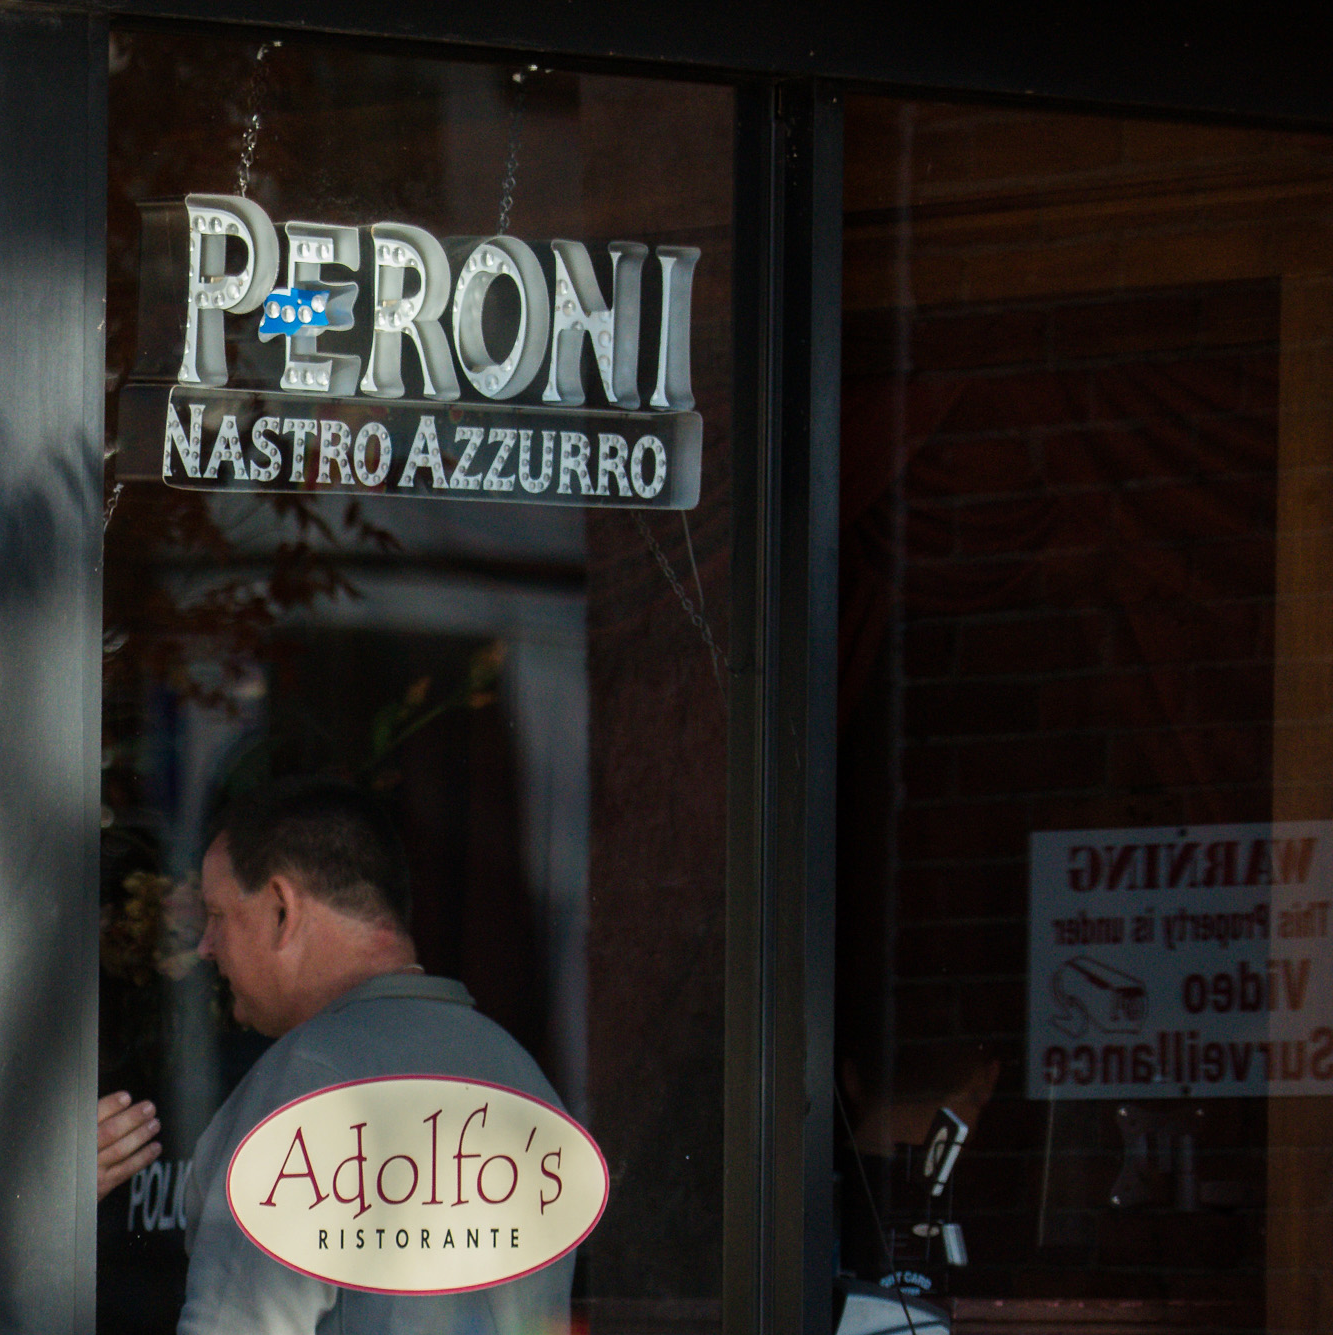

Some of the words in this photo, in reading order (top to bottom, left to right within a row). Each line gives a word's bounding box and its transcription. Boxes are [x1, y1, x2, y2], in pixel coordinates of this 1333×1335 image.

[178, 193, 701, 410] PERONI
[164, 402, 391, 486] NASTRO
[398, 415, 666, 499] AZZURRO
[259, 1102, 563, 1219] Adolfo's
[319, 1228, 521, 1250] RISTORANTE
